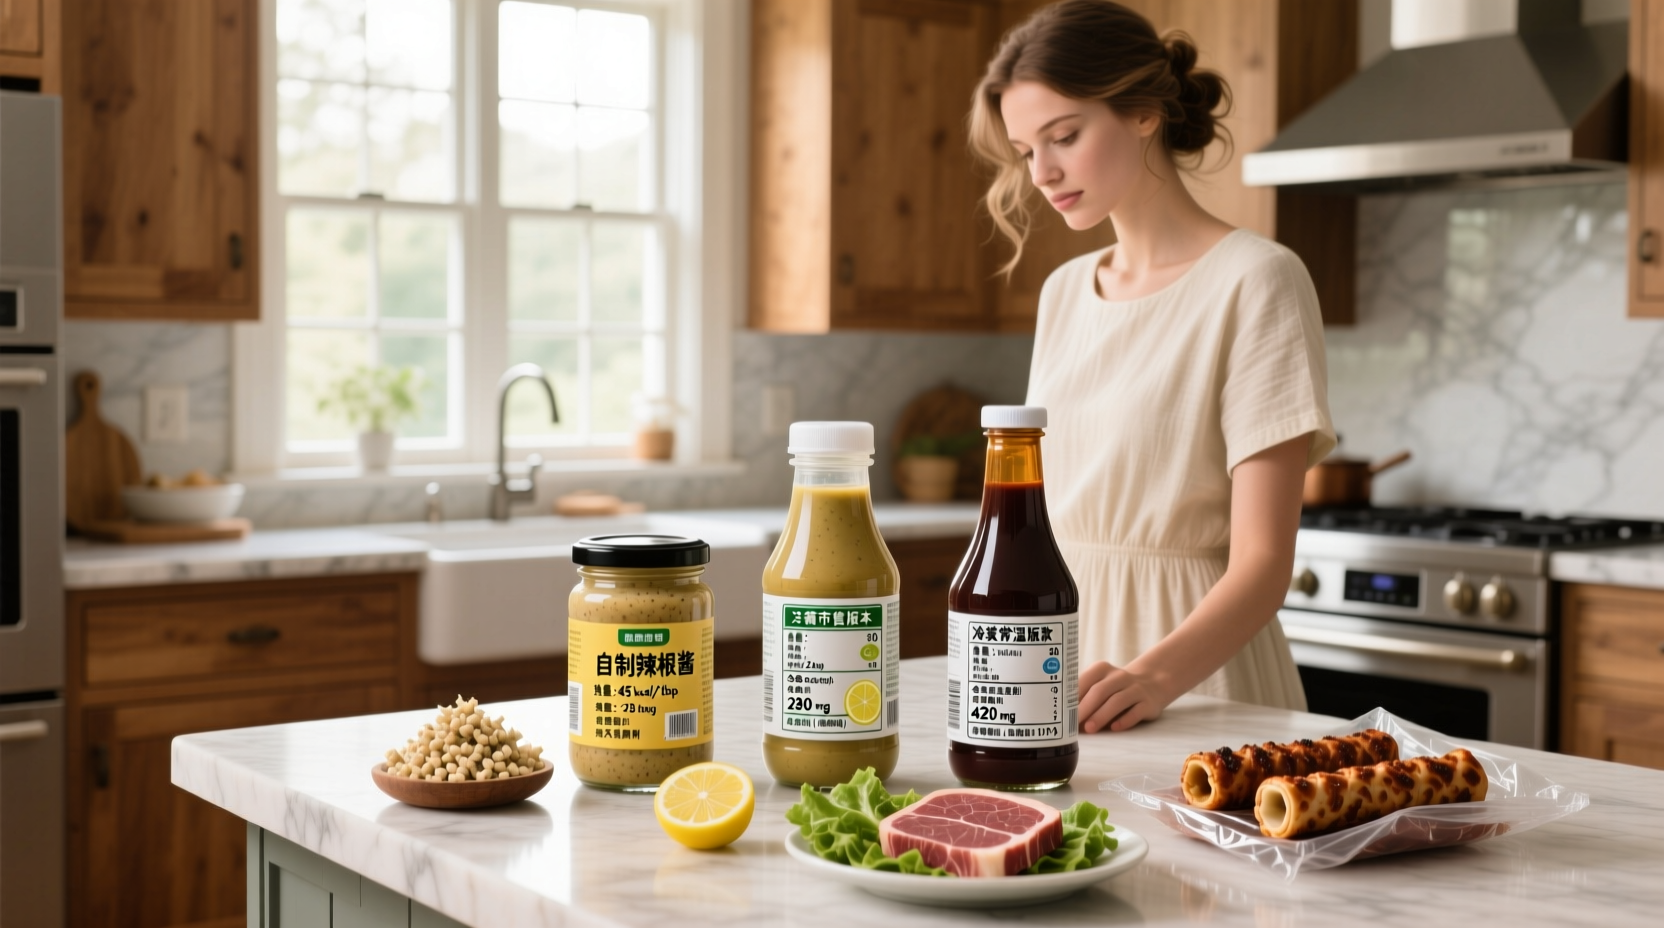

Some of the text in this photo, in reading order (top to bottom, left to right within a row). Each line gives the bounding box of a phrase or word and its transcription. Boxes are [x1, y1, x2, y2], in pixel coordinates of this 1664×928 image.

[596, 649, 695, 678] 自制辣根酱
[971, 706, 1016, 725] 420 mg
